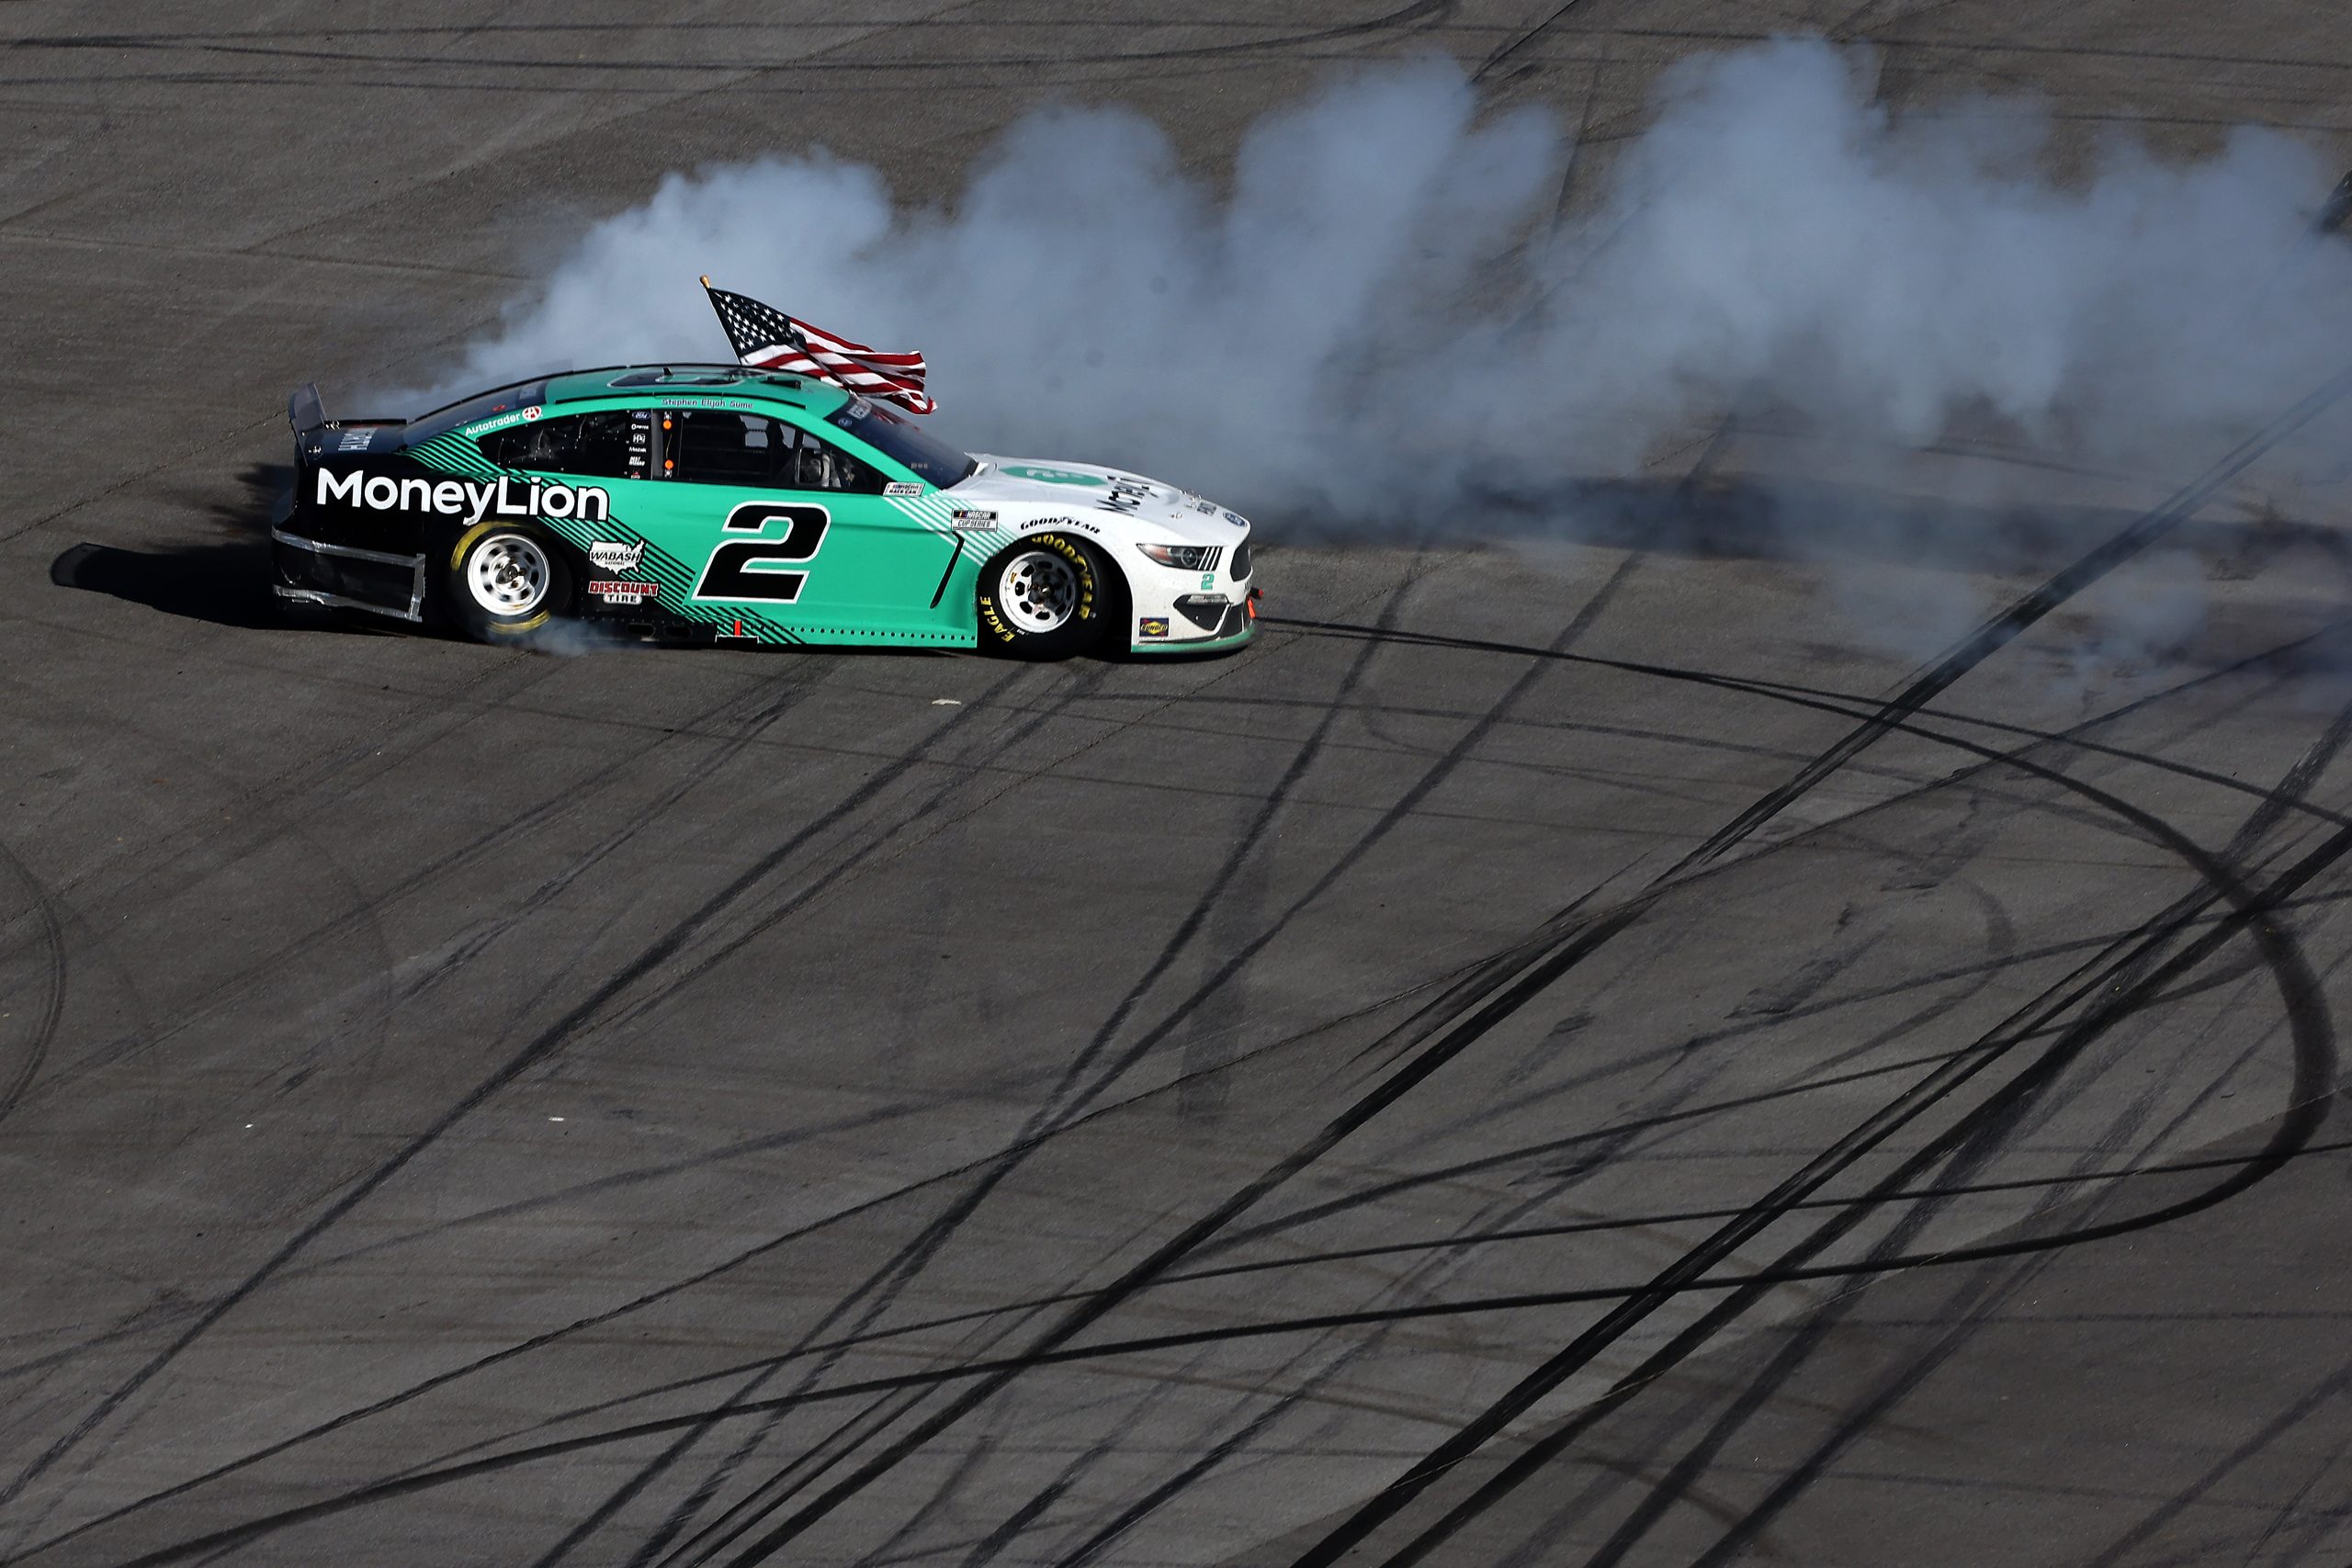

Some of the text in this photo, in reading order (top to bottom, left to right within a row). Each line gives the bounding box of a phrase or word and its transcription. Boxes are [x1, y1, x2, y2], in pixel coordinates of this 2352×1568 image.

[465, 412, 521, 437] Autotrader
[317, 468, 610, 526] MoneyLion
[591, 551, 641, 562] WABASH
[691, 500, 831, 604] 2
[588, 581, 659, 597] DISCOUNT
[1200, 572, 1215, 591] 2
[979, 596, 1015, 642] EAGLE
